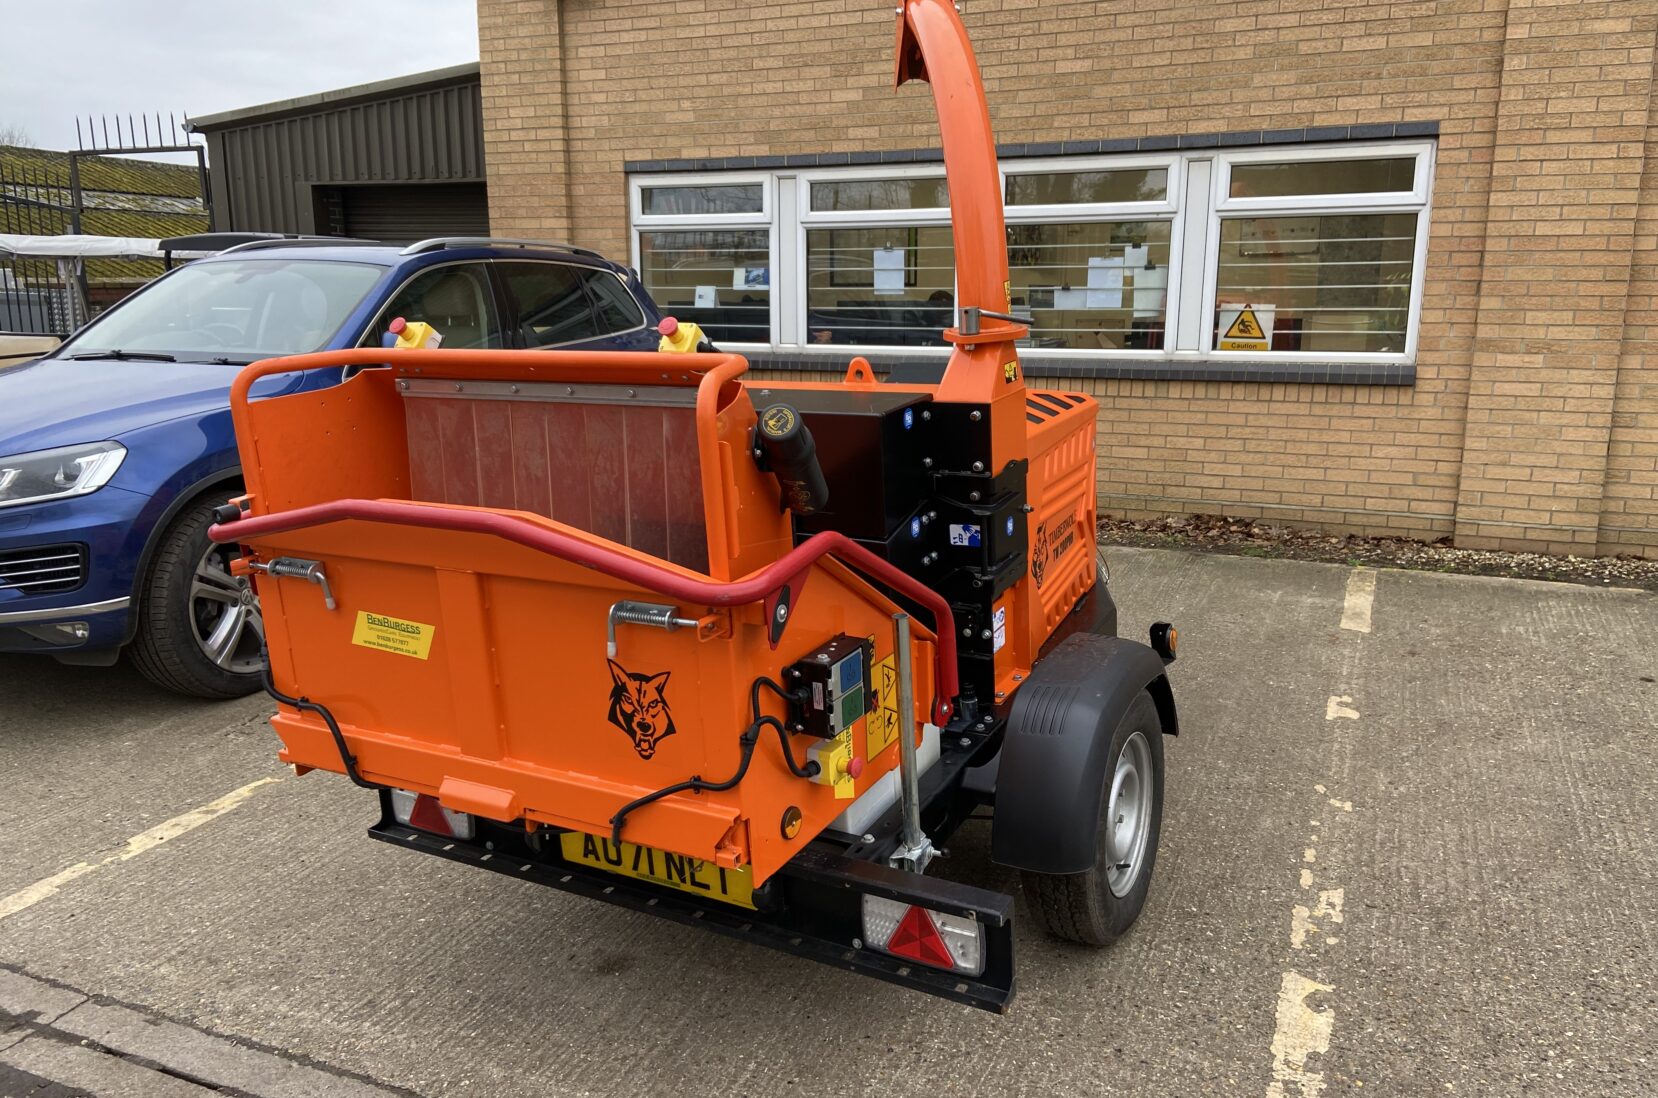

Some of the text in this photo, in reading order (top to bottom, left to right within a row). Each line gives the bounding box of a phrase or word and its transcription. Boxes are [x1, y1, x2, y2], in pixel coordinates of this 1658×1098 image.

[1231, 342, 1257, 350] Caution
[1048, 510, 1076, 546] TIMBERWOL
[363, 639, 418, 655] www.benburgess.co.uk
